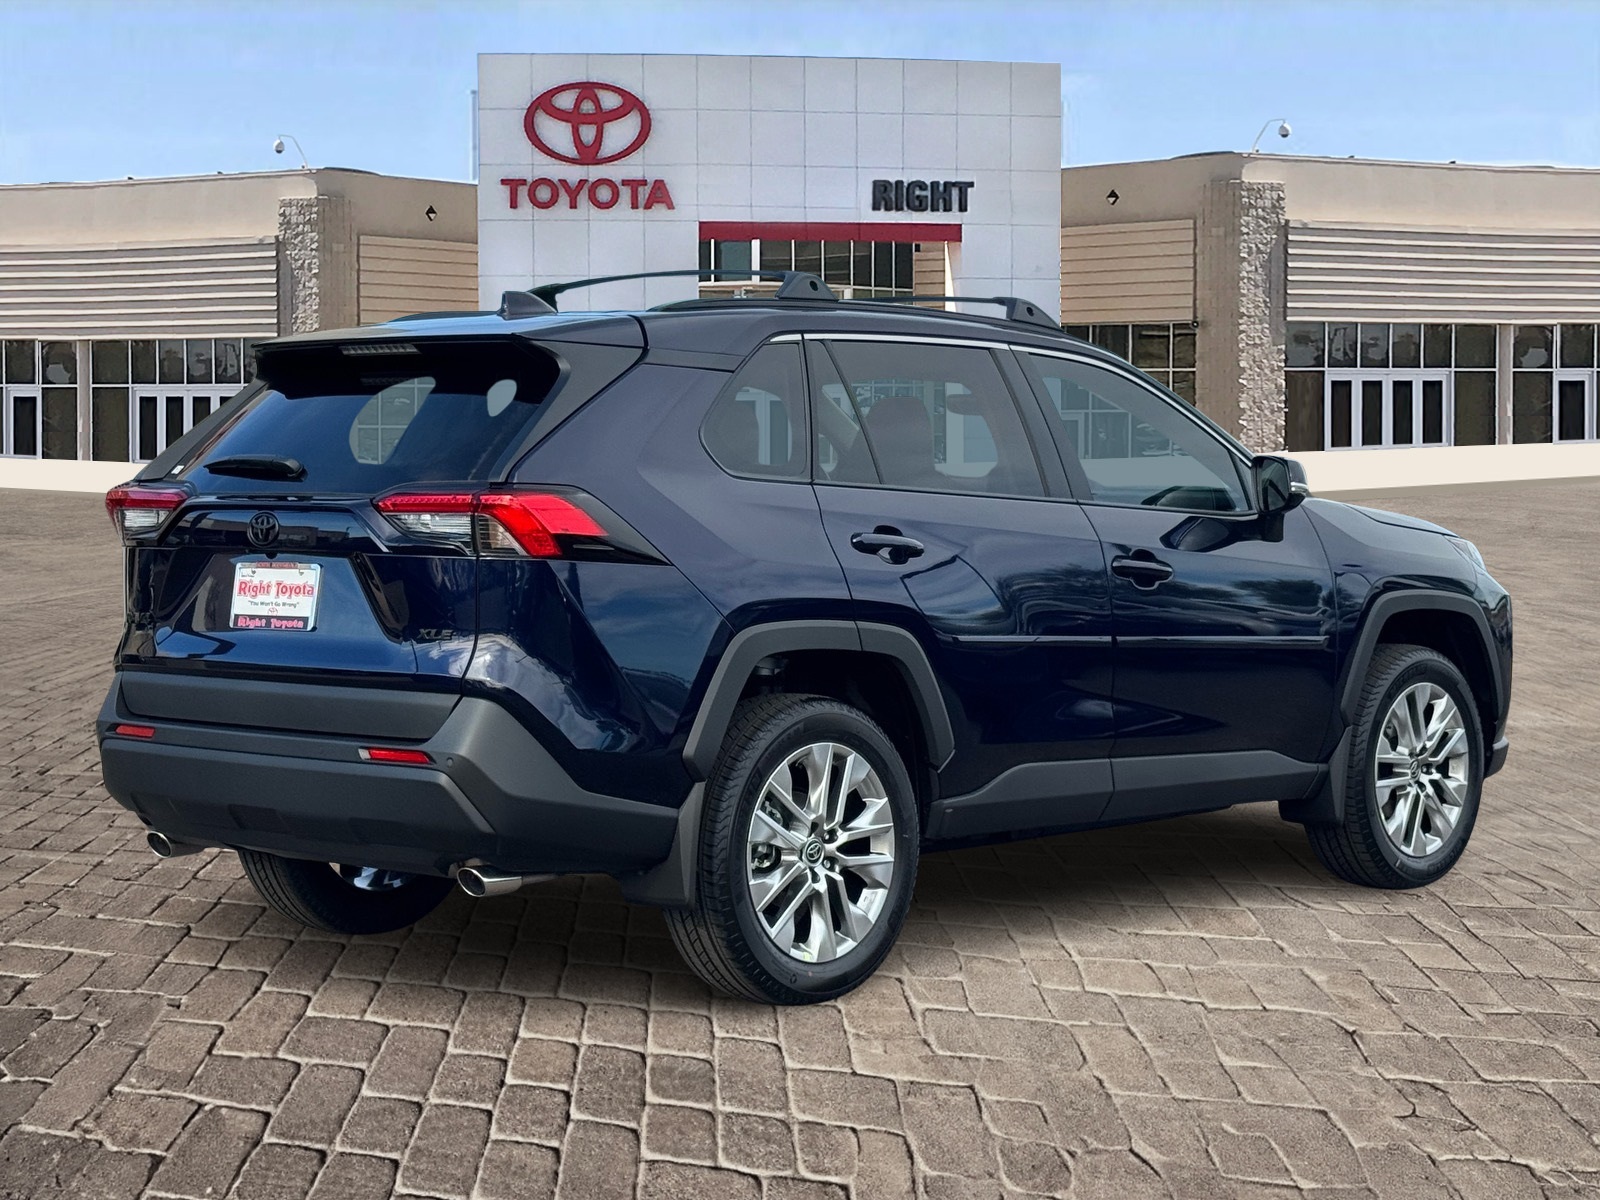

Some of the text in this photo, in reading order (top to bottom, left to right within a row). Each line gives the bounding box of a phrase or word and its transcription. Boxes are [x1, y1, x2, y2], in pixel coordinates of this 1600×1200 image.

[500, 178, 676, 211] TOYOTA
[871, 179, 976, 213] RIGHT
[237, 579, 315, 599] Right Toyota
[237, 616, 304, 630] Right Toyota
[416, 628, 454, 640] XLE
